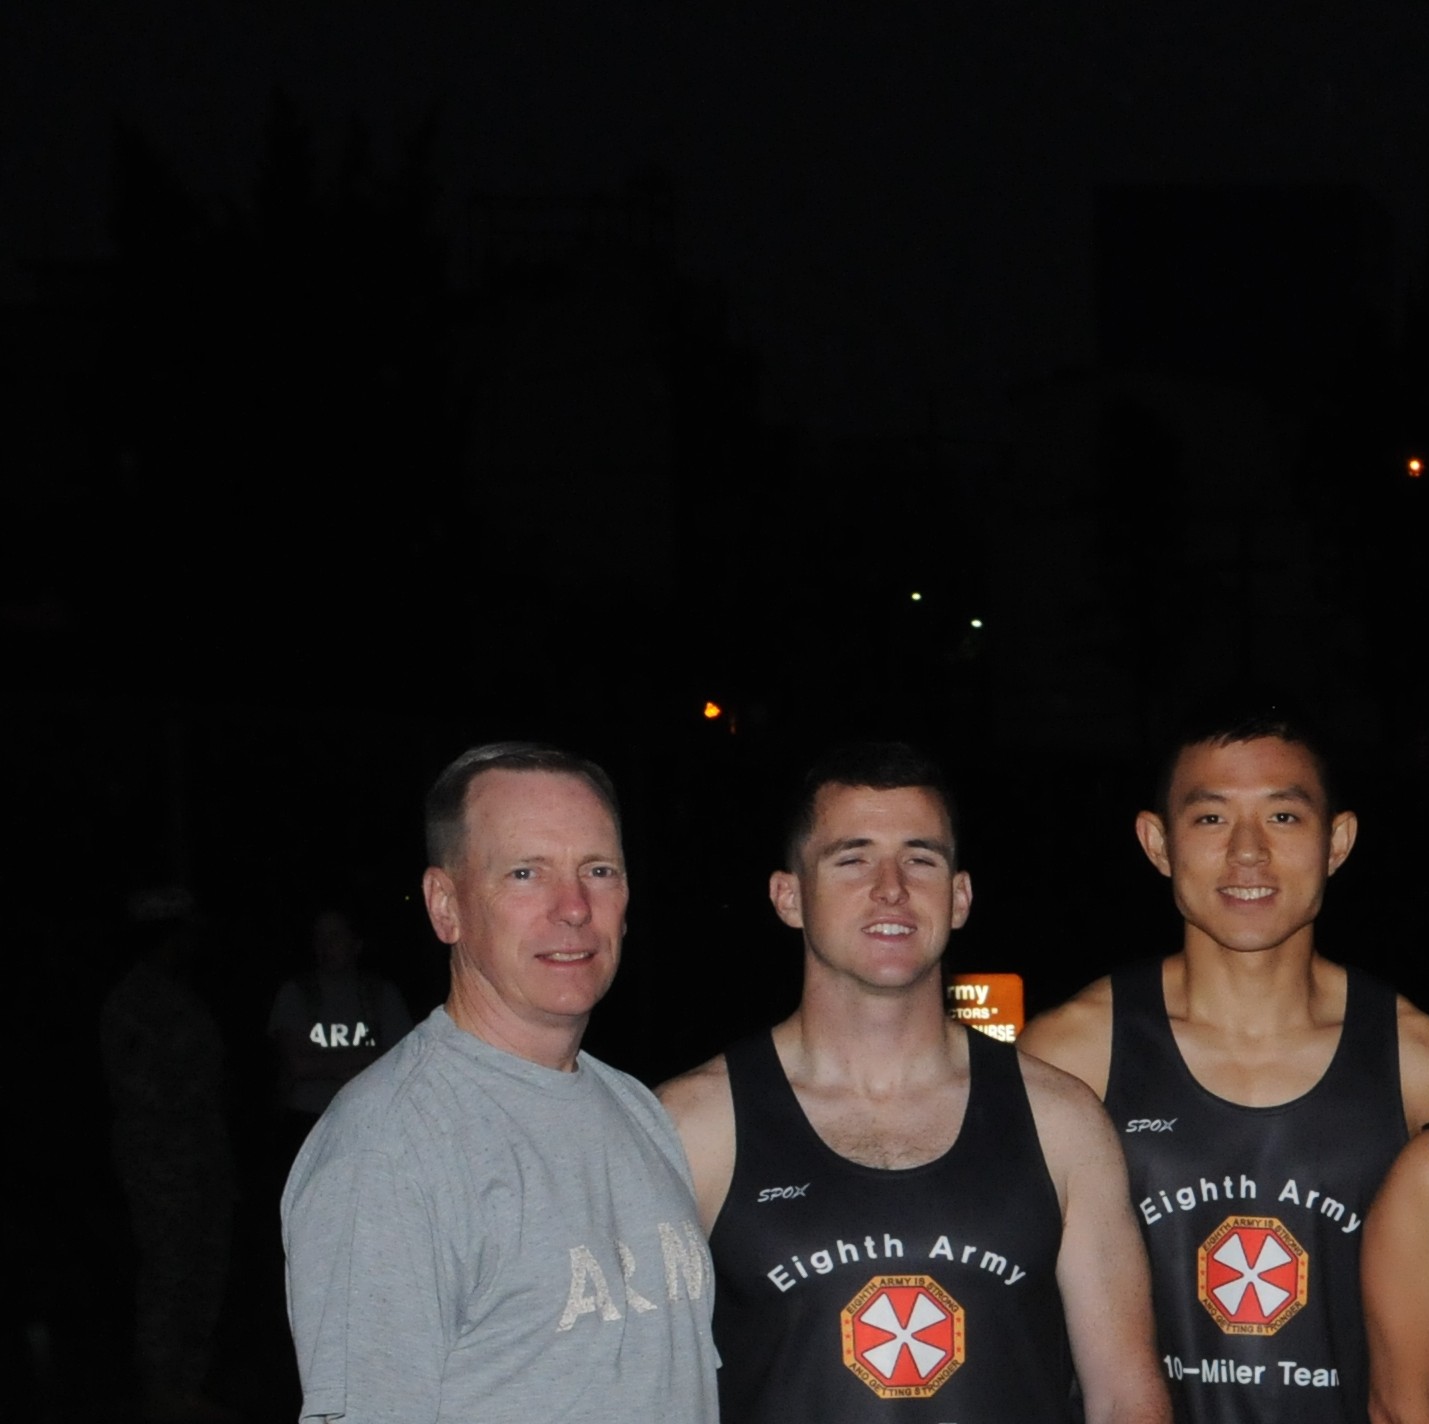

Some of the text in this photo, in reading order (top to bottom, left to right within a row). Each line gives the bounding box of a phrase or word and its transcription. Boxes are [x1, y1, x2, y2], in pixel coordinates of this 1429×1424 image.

[1126, 1118, 1178, 1132] SPOX
[757, 1183, 811, 1202] SPOX
[1140, 1175, 1361, 1233] Eighth Army
[1203, 1223, 1231, 1251] EIGHTH
[1275, 1226, 1303, 1256] STRONG
[767, 1234, 1026, 1293] Eighth Army
[847, 1283, 877, 1314] EIGHTH
[927, 1283, 959, 1312] STRONG
[1163, 1355, 1266, 1384] 10-Miler
